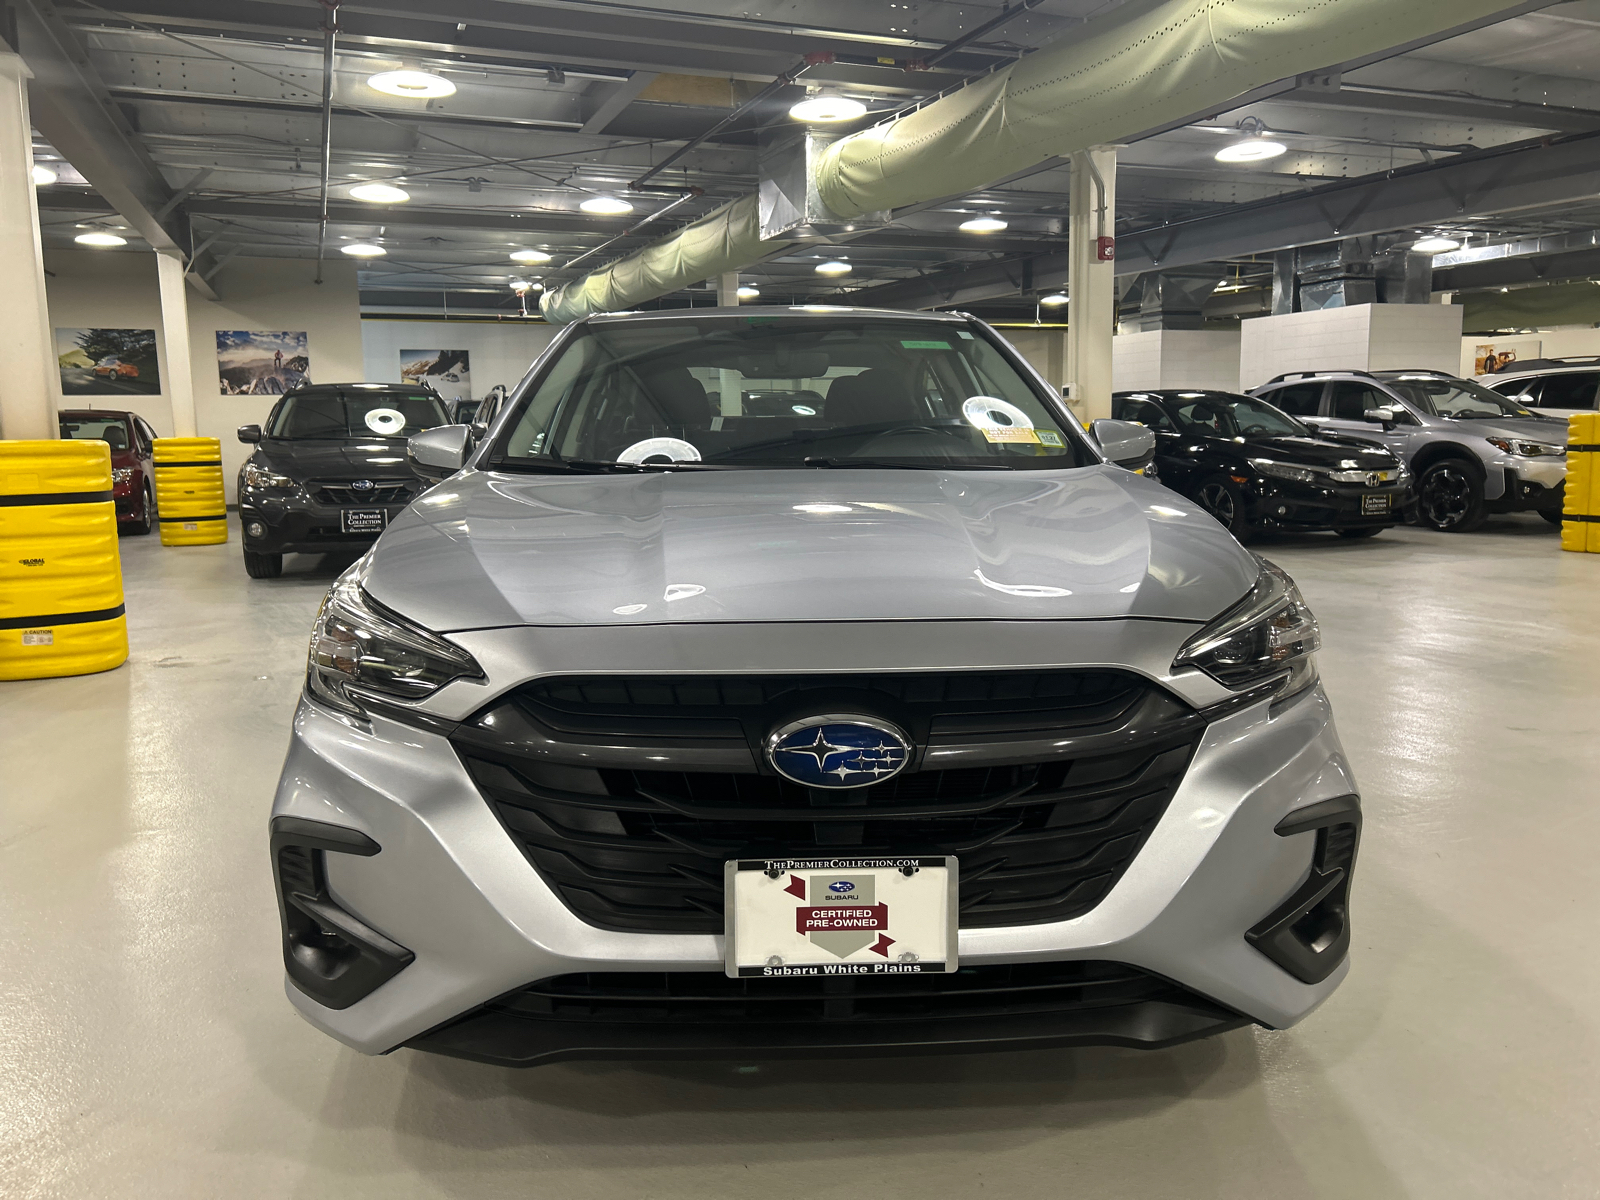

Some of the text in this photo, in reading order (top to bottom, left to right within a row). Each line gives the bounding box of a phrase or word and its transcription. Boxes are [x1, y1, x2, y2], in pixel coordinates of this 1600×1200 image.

[812, 910, 872, 918] CERTIFIED
[806, 919, 878, 927] PRE-OWNED
[763, 964, 921, 976] Subaru White Plains
